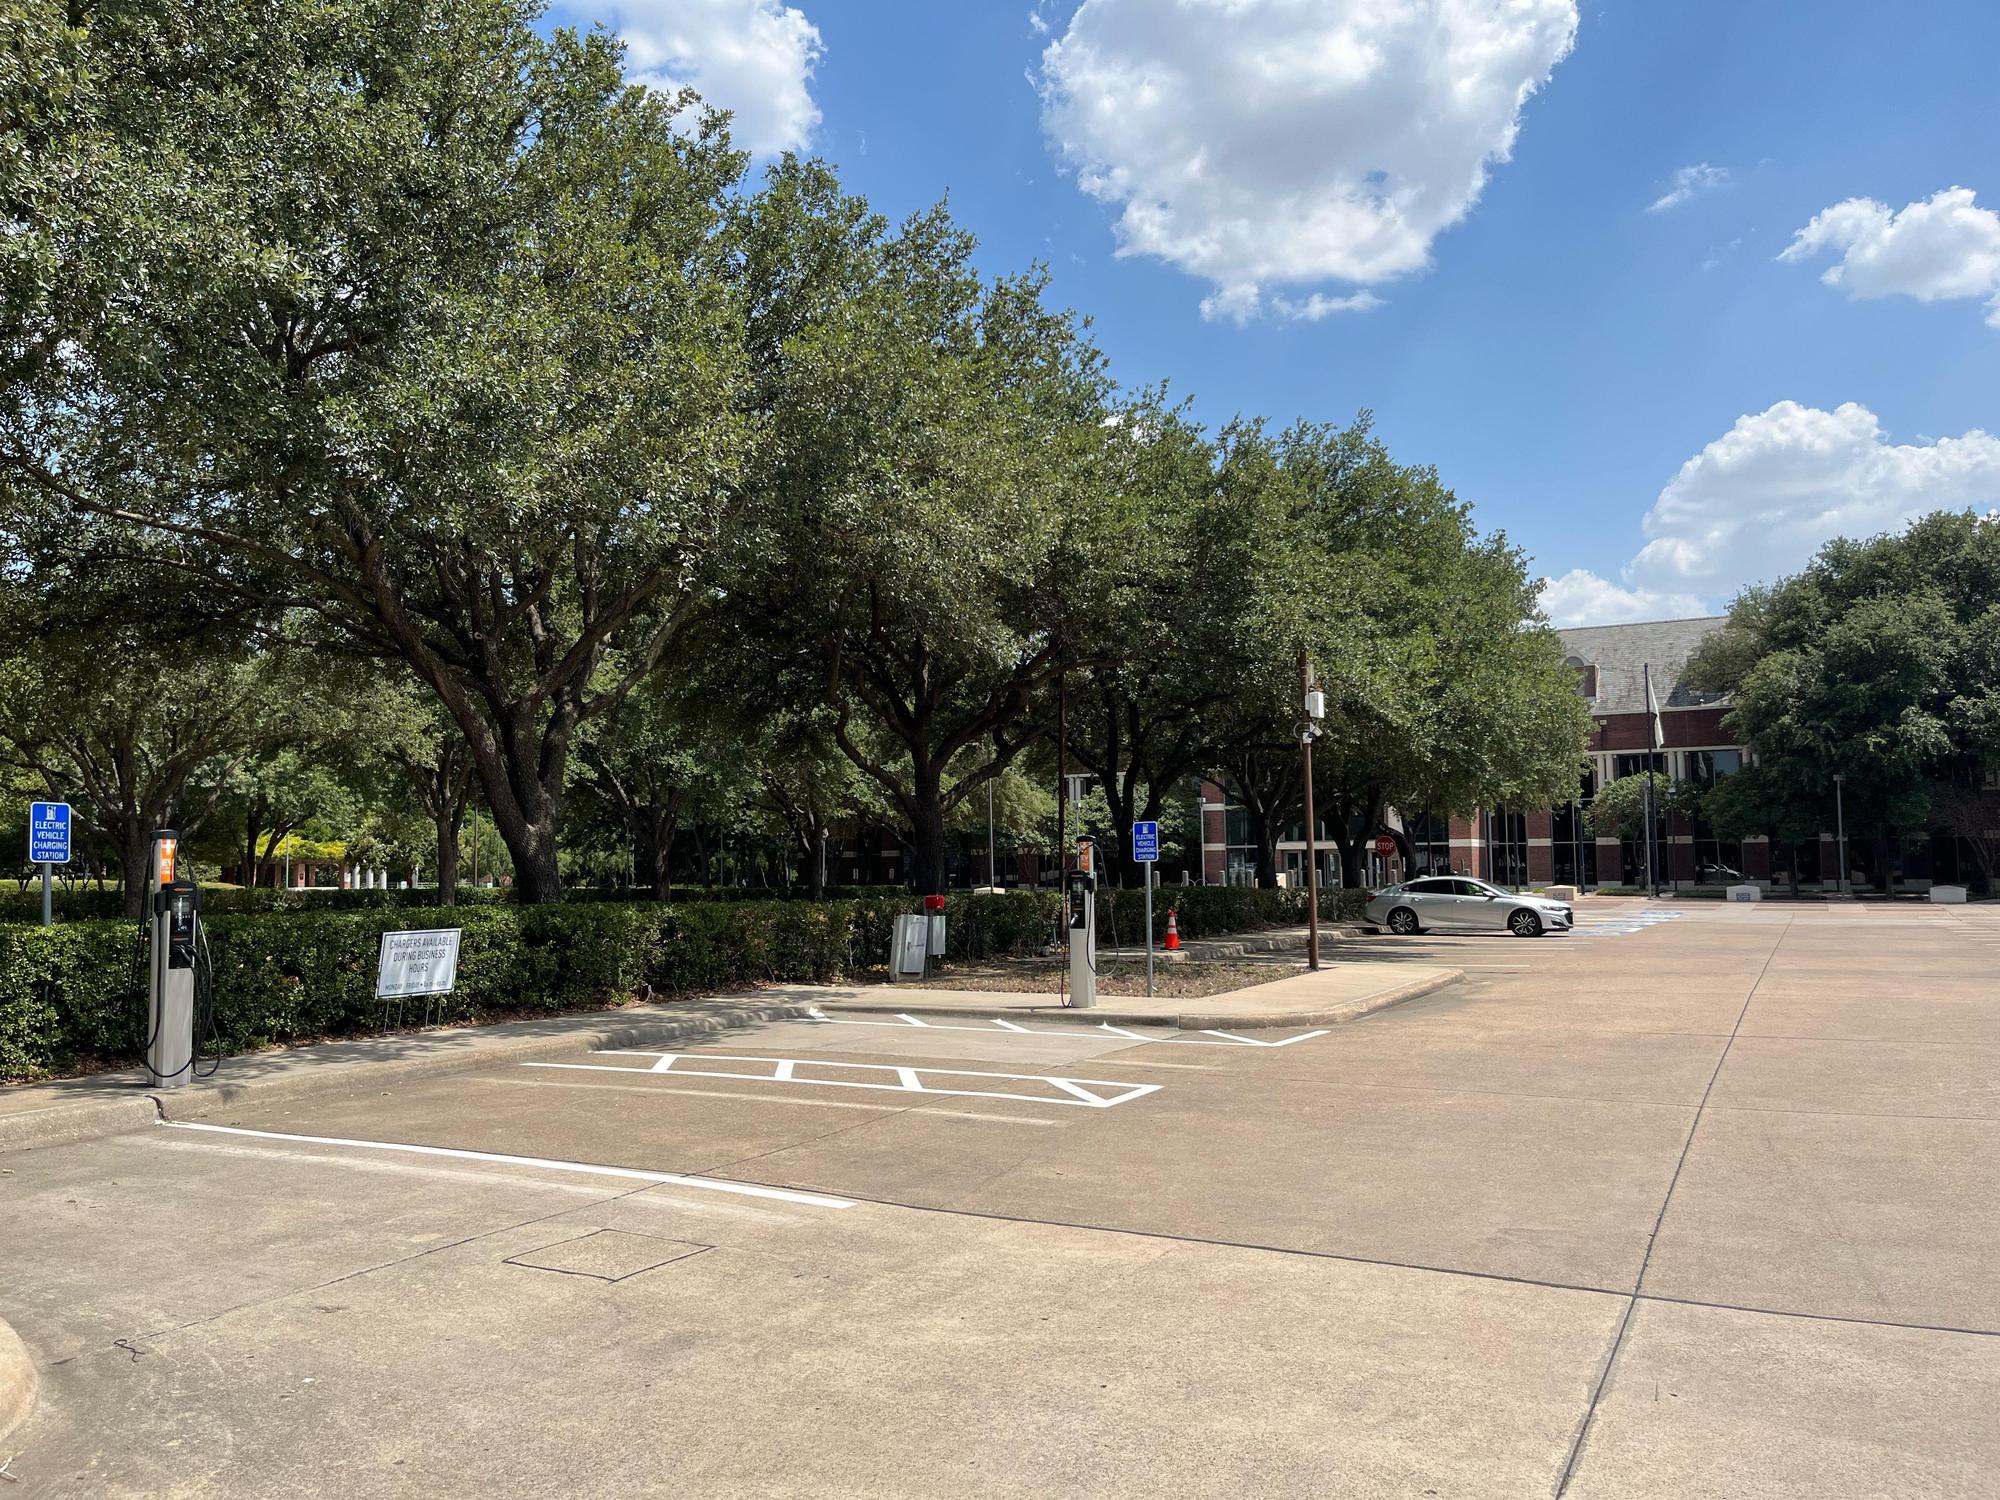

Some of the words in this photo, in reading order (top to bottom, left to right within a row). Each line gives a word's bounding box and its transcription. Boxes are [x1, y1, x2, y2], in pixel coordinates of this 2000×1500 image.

[35, 821, 67, 830] ELECTRIC
[36, 831, 65, 840] VEHICLE
[33, 841, 68, 850] CHARGING
[1376, 842, 1394, 850] STOP
[36, 851, 65, 860] STATION
[389, 938, 421, 950] CHARGERS
[421, 936, 453, 947] AVAILABLE
[393, 951, 417, 962] DURING
[417, 949, 446, 960] BUSINESS
[408, 962, 429, 973] HOURS
